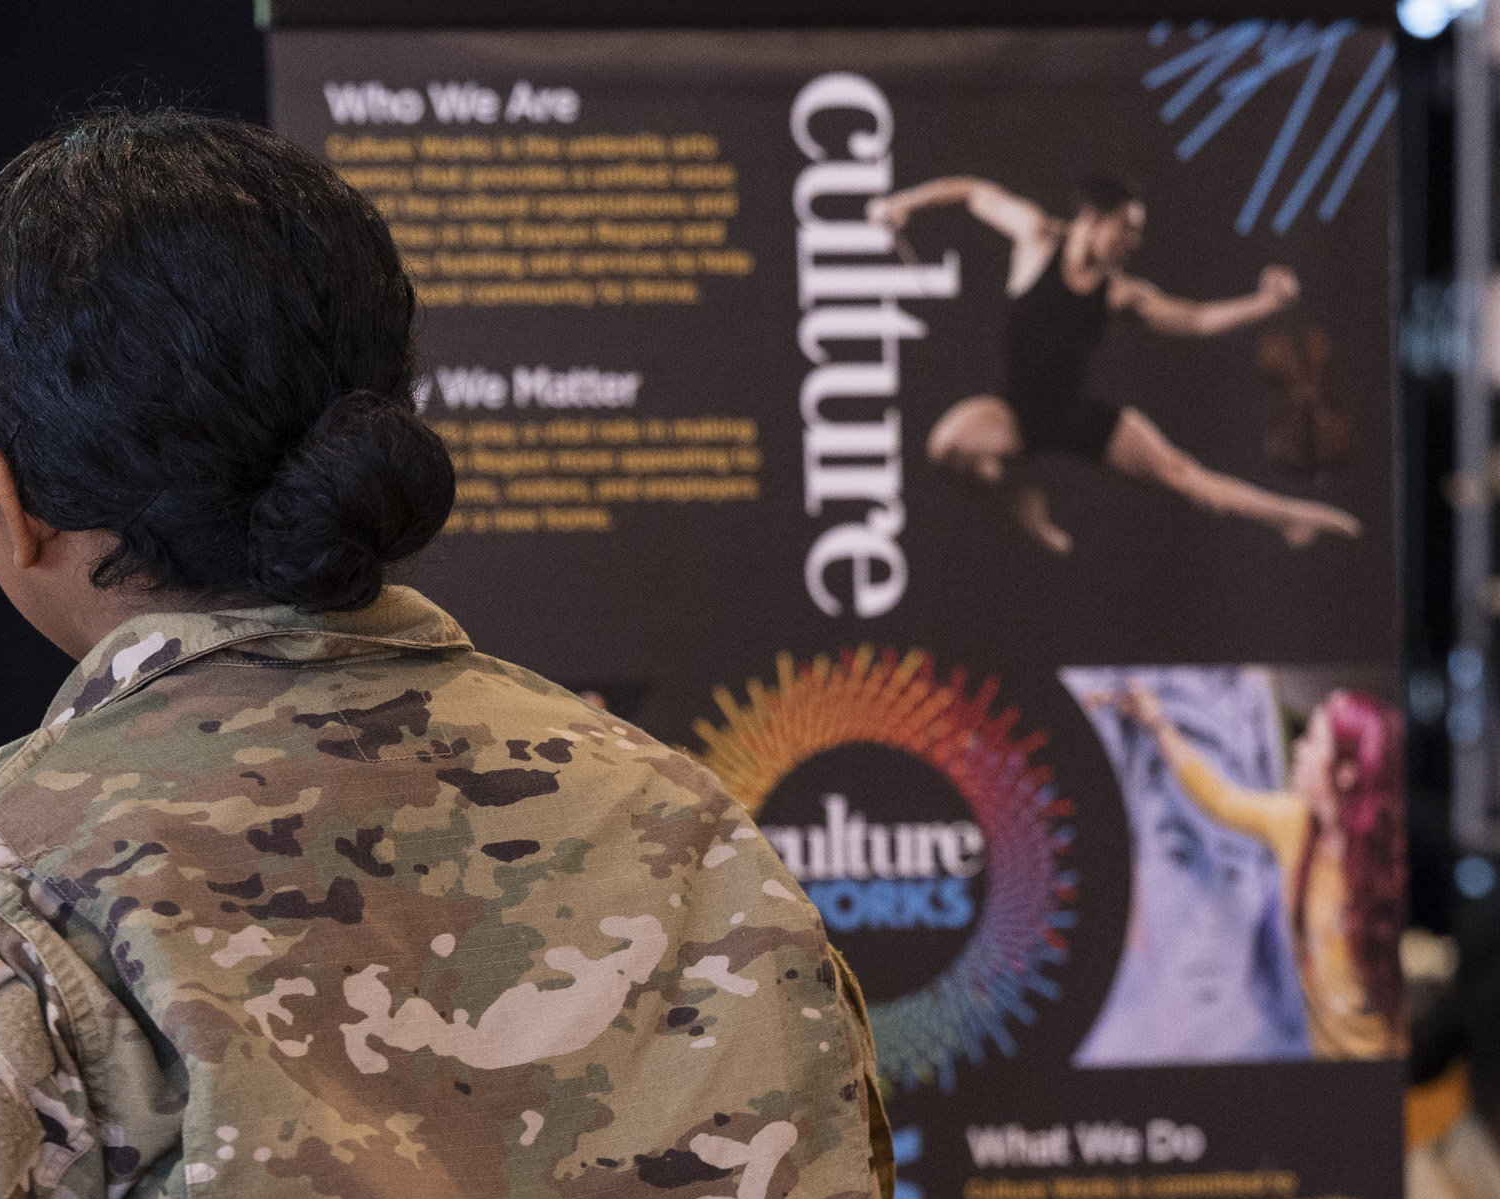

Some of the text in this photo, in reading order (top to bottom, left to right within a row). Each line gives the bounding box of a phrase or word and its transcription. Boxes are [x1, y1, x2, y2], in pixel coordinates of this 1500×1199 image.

[324, 81, 580, 124] Who We Are
[791, 72, 961, 617] culture
[437, 367, 507, 408] We
[512, 367, 641, 407] Matter
[762, 794, 986, 880] ulture
[809, 876, 975, 933] ORKS
[967, 1120, 1206, 1166] What We Do
